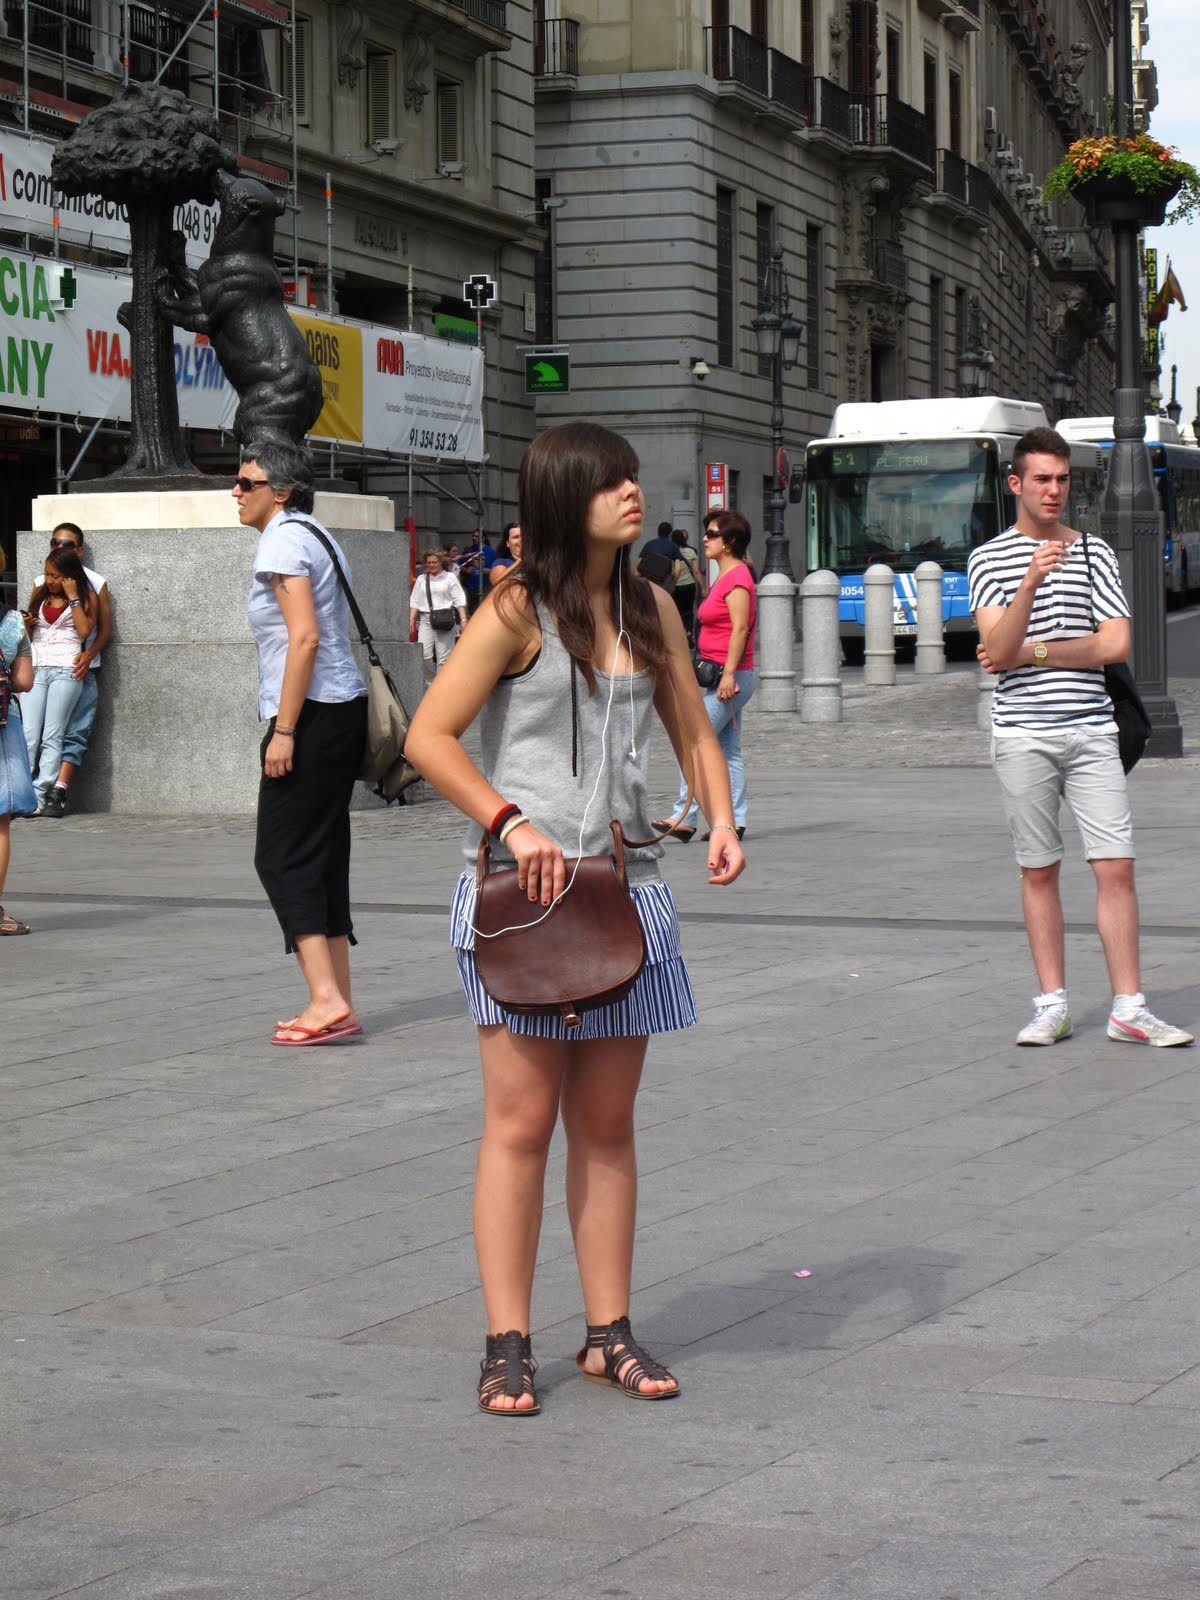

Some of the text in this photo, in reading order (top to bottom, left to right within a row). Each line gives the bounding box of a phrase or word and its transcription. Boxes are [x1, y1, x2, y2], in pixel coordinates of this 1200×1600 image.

[0, 256, 56, 323] CIA
[405, 360, 431, 379] Proyectos
[435, 366, 472, 386] Rehabilitaciones
[409, 427, 458, 452] 91 354 53 28
